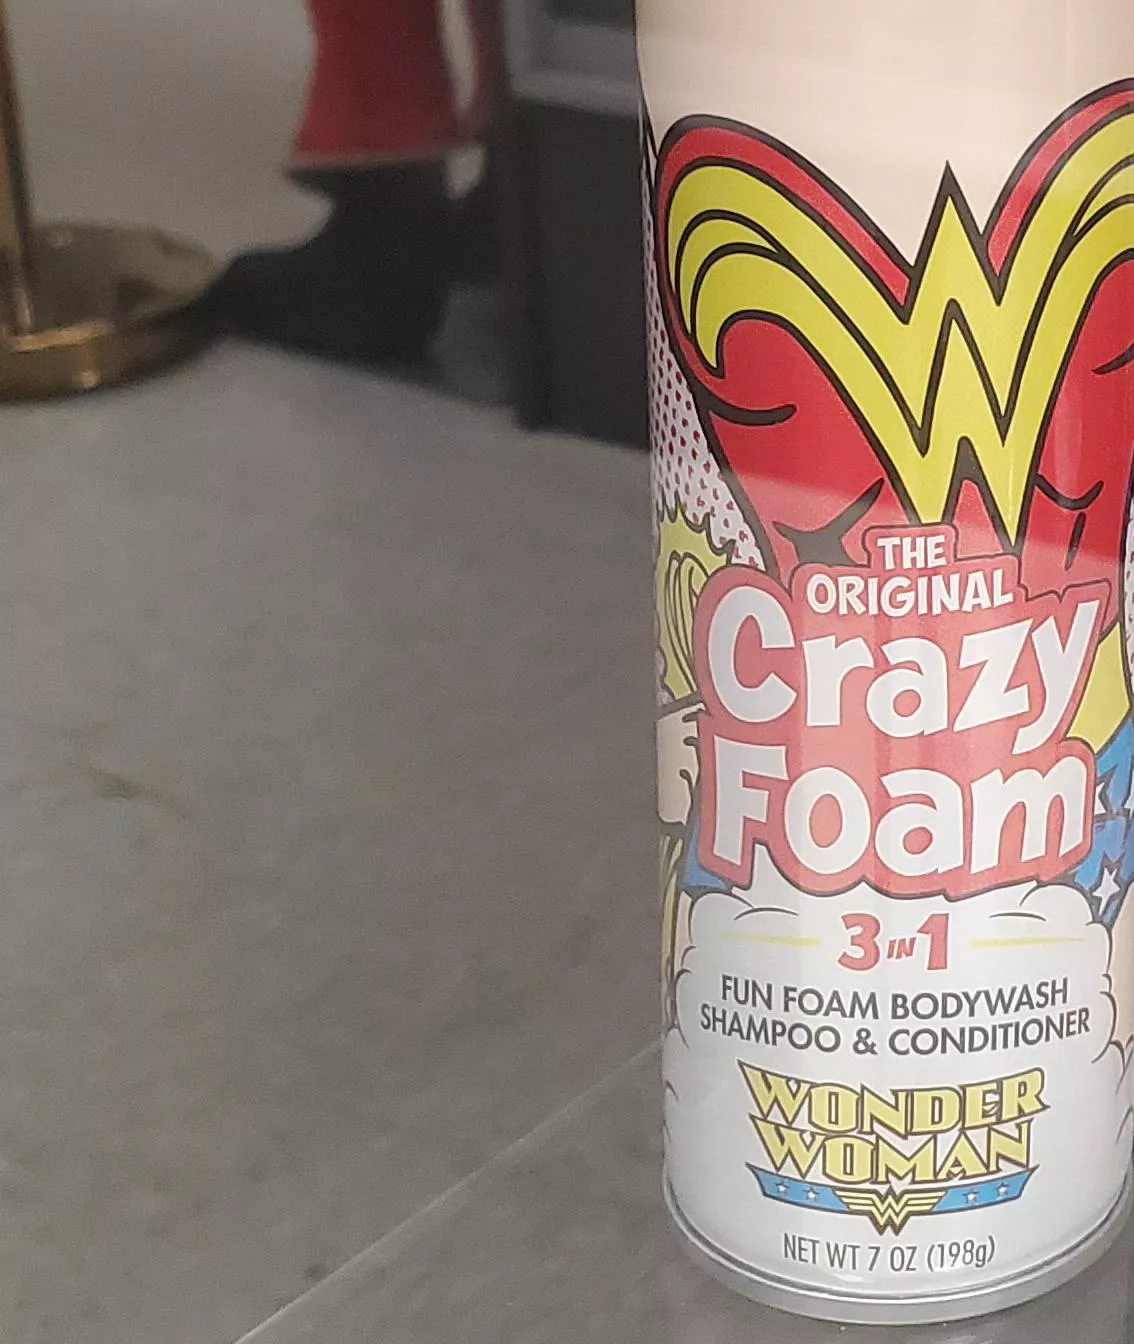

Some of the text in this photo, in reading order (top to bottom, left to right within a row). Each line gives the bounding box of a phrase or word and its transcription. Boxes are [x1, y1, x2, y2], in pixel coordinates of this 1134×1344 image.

[877, 535, 947, 571] THE
[806, 568, 1014, 617] ORIGINAL
[708, 585, 1100, 755] Crazy
[713, 735, 1088, 877] Foam
[837, 912, 950, 971] 3 IN 1
[720, 973, 1069, 1021] FUN FOAM BODYWASH
[700, 1002, 1091, 1056] SHAMPOO & CONDITIONER
[737, 1057, 1051, 1139] WONDER
[748, 1111, 1034, 1186] WOMAN
[783, 1232, 996, 1274] NET WT 7 OZ (198g)
